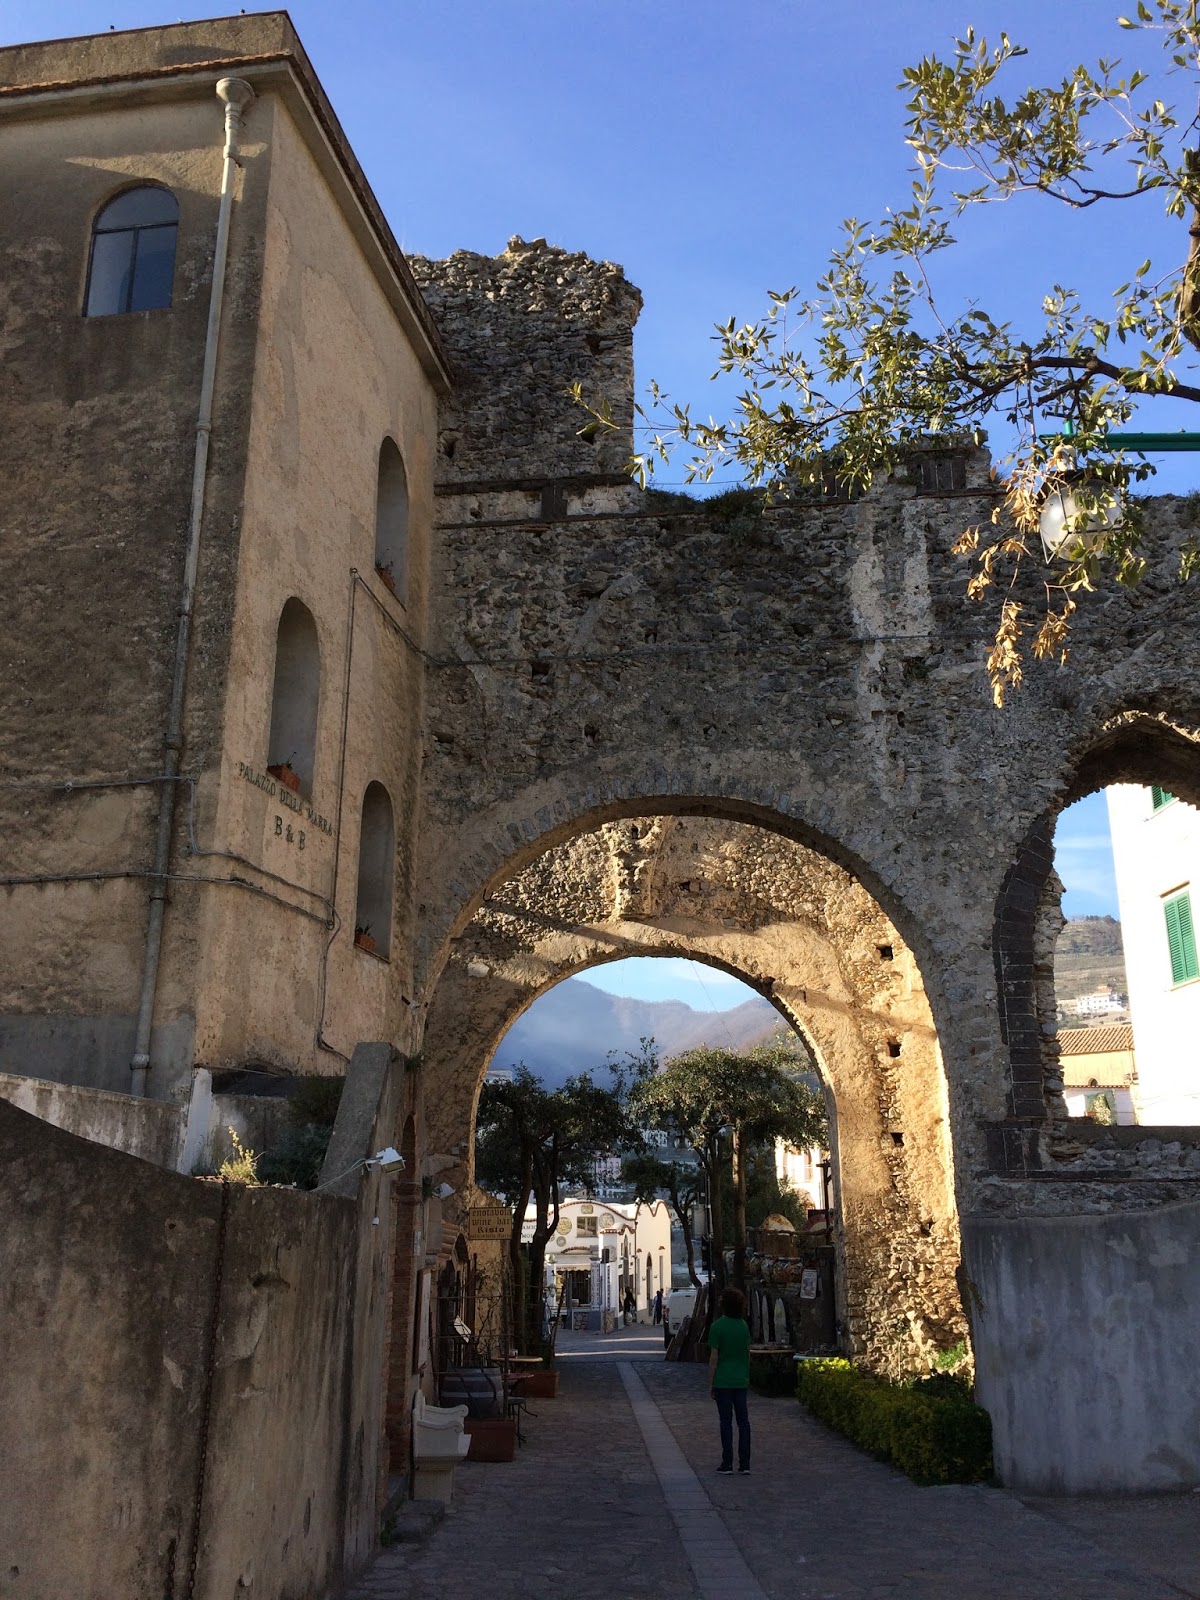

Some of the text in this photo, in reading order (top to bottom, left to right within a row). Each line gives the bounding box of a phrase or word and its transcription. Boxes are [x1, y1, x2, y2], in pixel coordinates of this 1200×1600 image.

[239, 761, 332, 836] PALAZZO DELLA MARRA
[471, 1216, 511, 1226] wine bar
[477, 1226, 505, 1234] Risto
